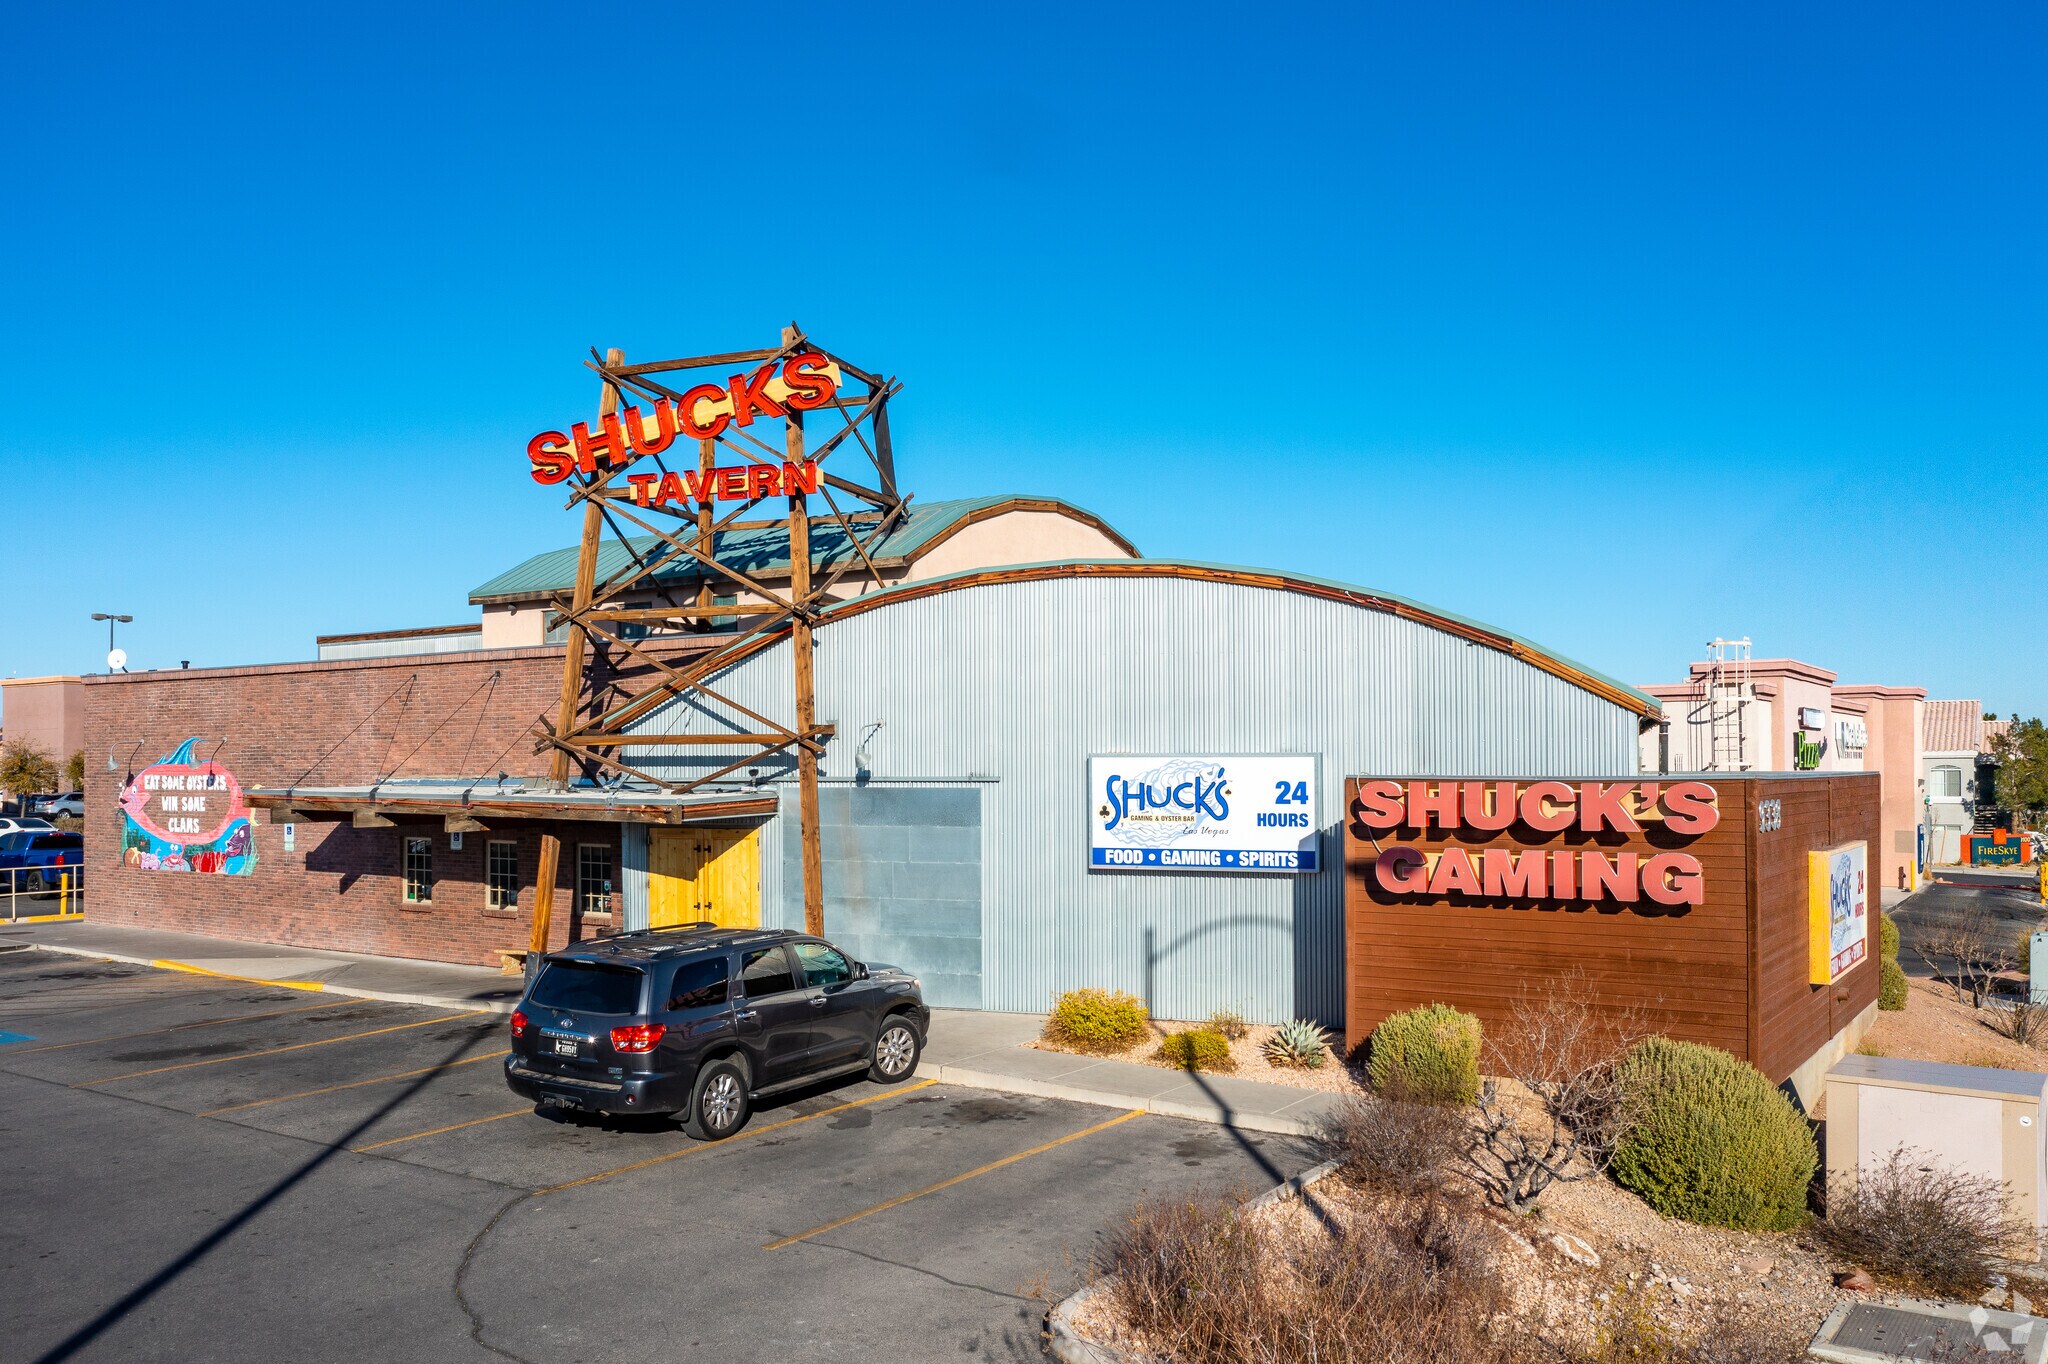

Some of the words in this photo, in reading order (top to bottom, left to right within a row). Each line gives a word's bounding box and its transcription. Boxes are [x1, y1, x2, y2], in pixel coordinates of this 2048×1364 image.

[527, 352, 837, 485] SHUCKS
[627, 459, 818, 507] TAVERN
[144, 775, 160, 790] EAT
[161, 775, 184, 790] SOME
[1275, 780, 1309, 805] 24
[161, 796, 178, 811] WIN
[182, 796, 206, 811] SOME
[1105, 767, 1229, 830] SHUCK'S
[1358, 780, 1721, 835] SHUCK'S
[168, 818, 200, 833] CLAMS
[1182, 826, 1198, 834] Las
[1200, 826, 1229, 837] Vegas
[1257, 812, 1309, 827] HOURS
[1105, 849, 1143, 864] FOOD
[1161, 850, 1221, 866] GAMING
[1239, 851, 1299, 867] SPIRITS
[1375, 846, 1706, 906] GAMING
[1858, 869, 1864, 894] 24
